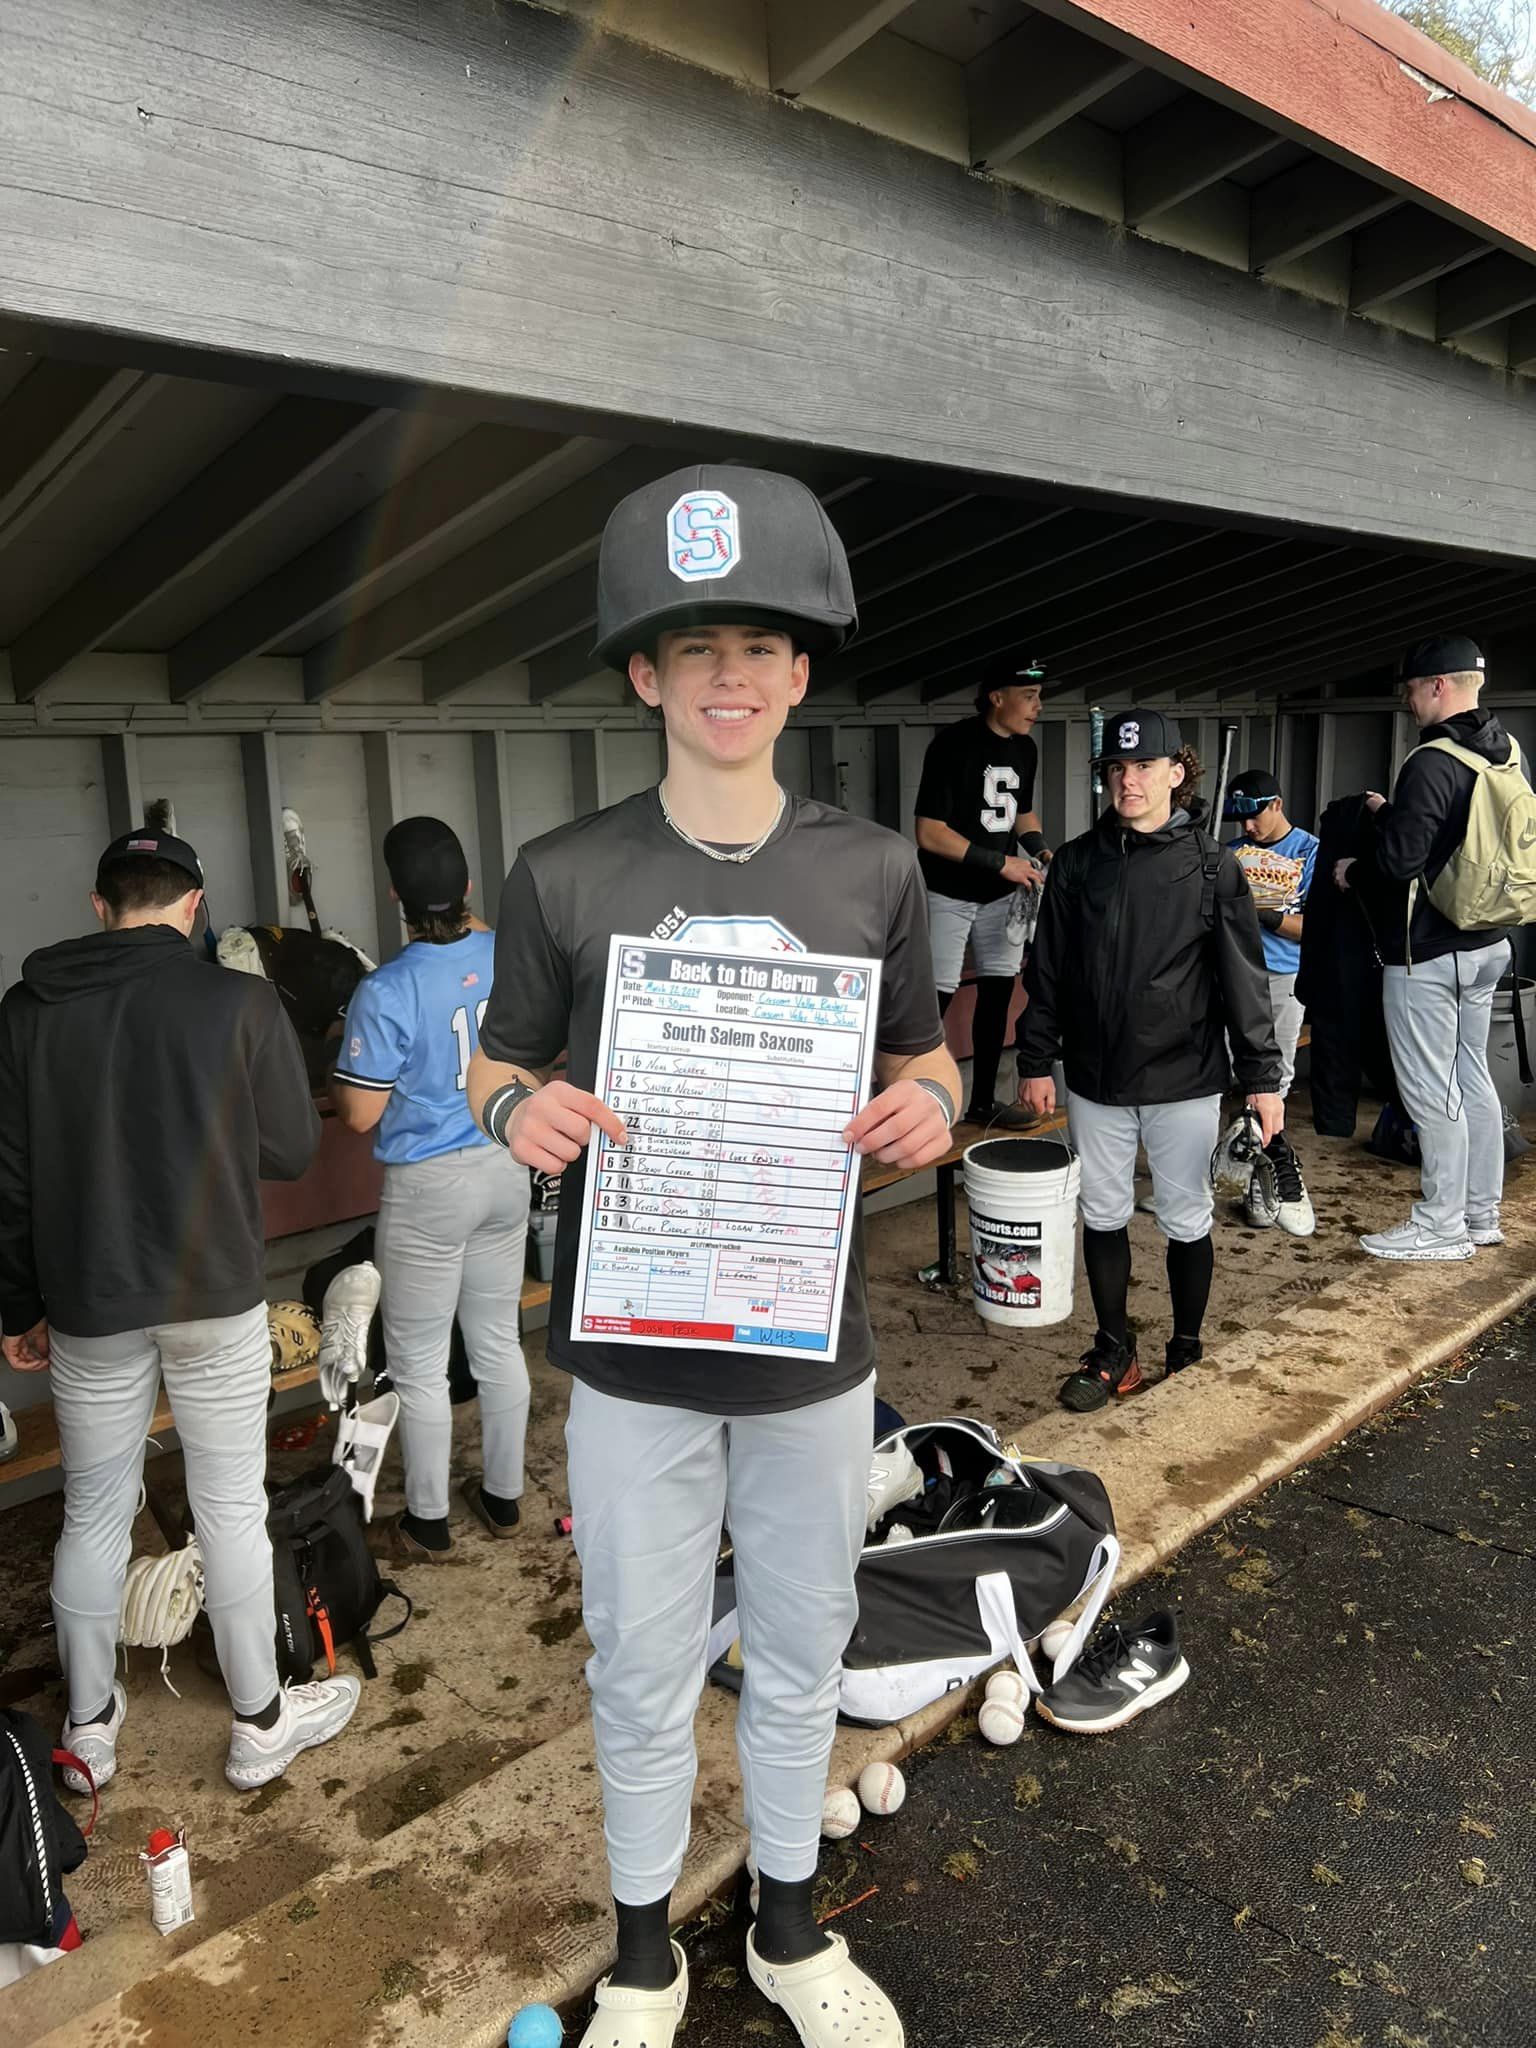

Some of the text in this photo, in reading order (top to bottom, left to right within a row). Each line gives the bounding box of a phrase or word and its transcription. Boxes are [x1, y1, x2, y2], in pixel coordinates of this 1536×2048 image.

[667, 490, 740, 582] S
[1118, 721, 1140, 750] S
[980, 765, 1020, 833] S
[622, 949, 646, 978] S
[670, 959, 818, 994] Back to the Berm
[623, 980, 643, 991] Date:
[632, 995, 654, 1007] Pitch:
[716, 989, 754, 1001] Opponent:
[715, 1004, 750, 1017] Location:
[662, 1021, 814, 1053] South Salem Saxons
[619, 1055, 624, 1067] 1
[631, 1055, 642, 1068] 16
[615, 1075, 622, 1088] 2
[630, 1074, 636, 1088] 6
[613, 1096, 620, 1108] 3
[628, 1097, 637, 1109] 14
[627, 1116, 640, 1128] 22
[608, 1157, 614, 1168] 6
[622, 1156, 630, 1168] 5
[605, 1176, 612, 1187] 7
[620, 1177, 629, 1189] 11
[603, 1195, 610, 1207] 8
[619, 1195, 627, 1207] 3
[1006, 1291, 1036, 1305] JUGS
